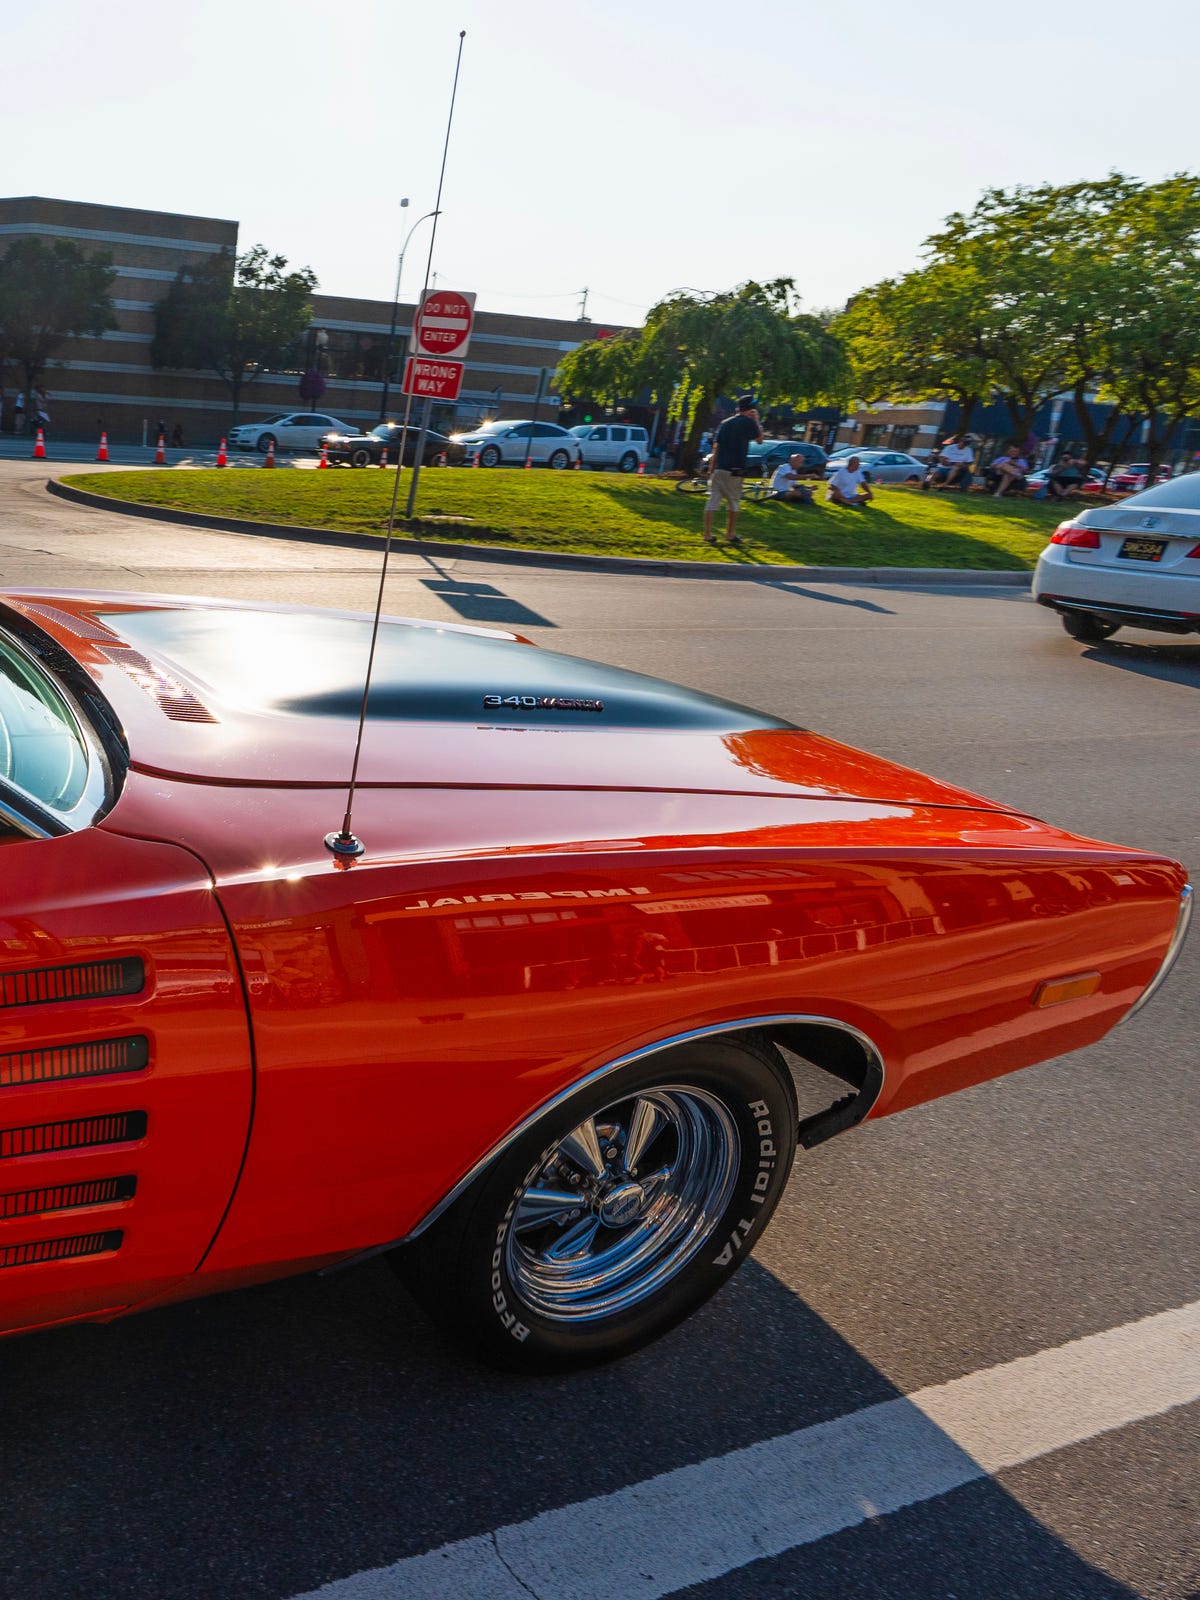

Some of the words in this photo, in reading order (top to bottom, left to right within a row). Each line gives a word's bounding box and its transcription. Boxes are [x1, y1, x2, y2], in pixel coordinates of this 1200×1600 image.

[424, 302, 439, 313] DO
[444, 304, 467, 315] NOT
[424, 331, 457, 343] ENTER
[414, 364, 457, 379] WRONG
[417, 379, 446, 392] WAY
[484, 694, 536, 708] 340
[748, 1099, 777, 1204] Radial
[712, 1218, 756, 1266] T/A
